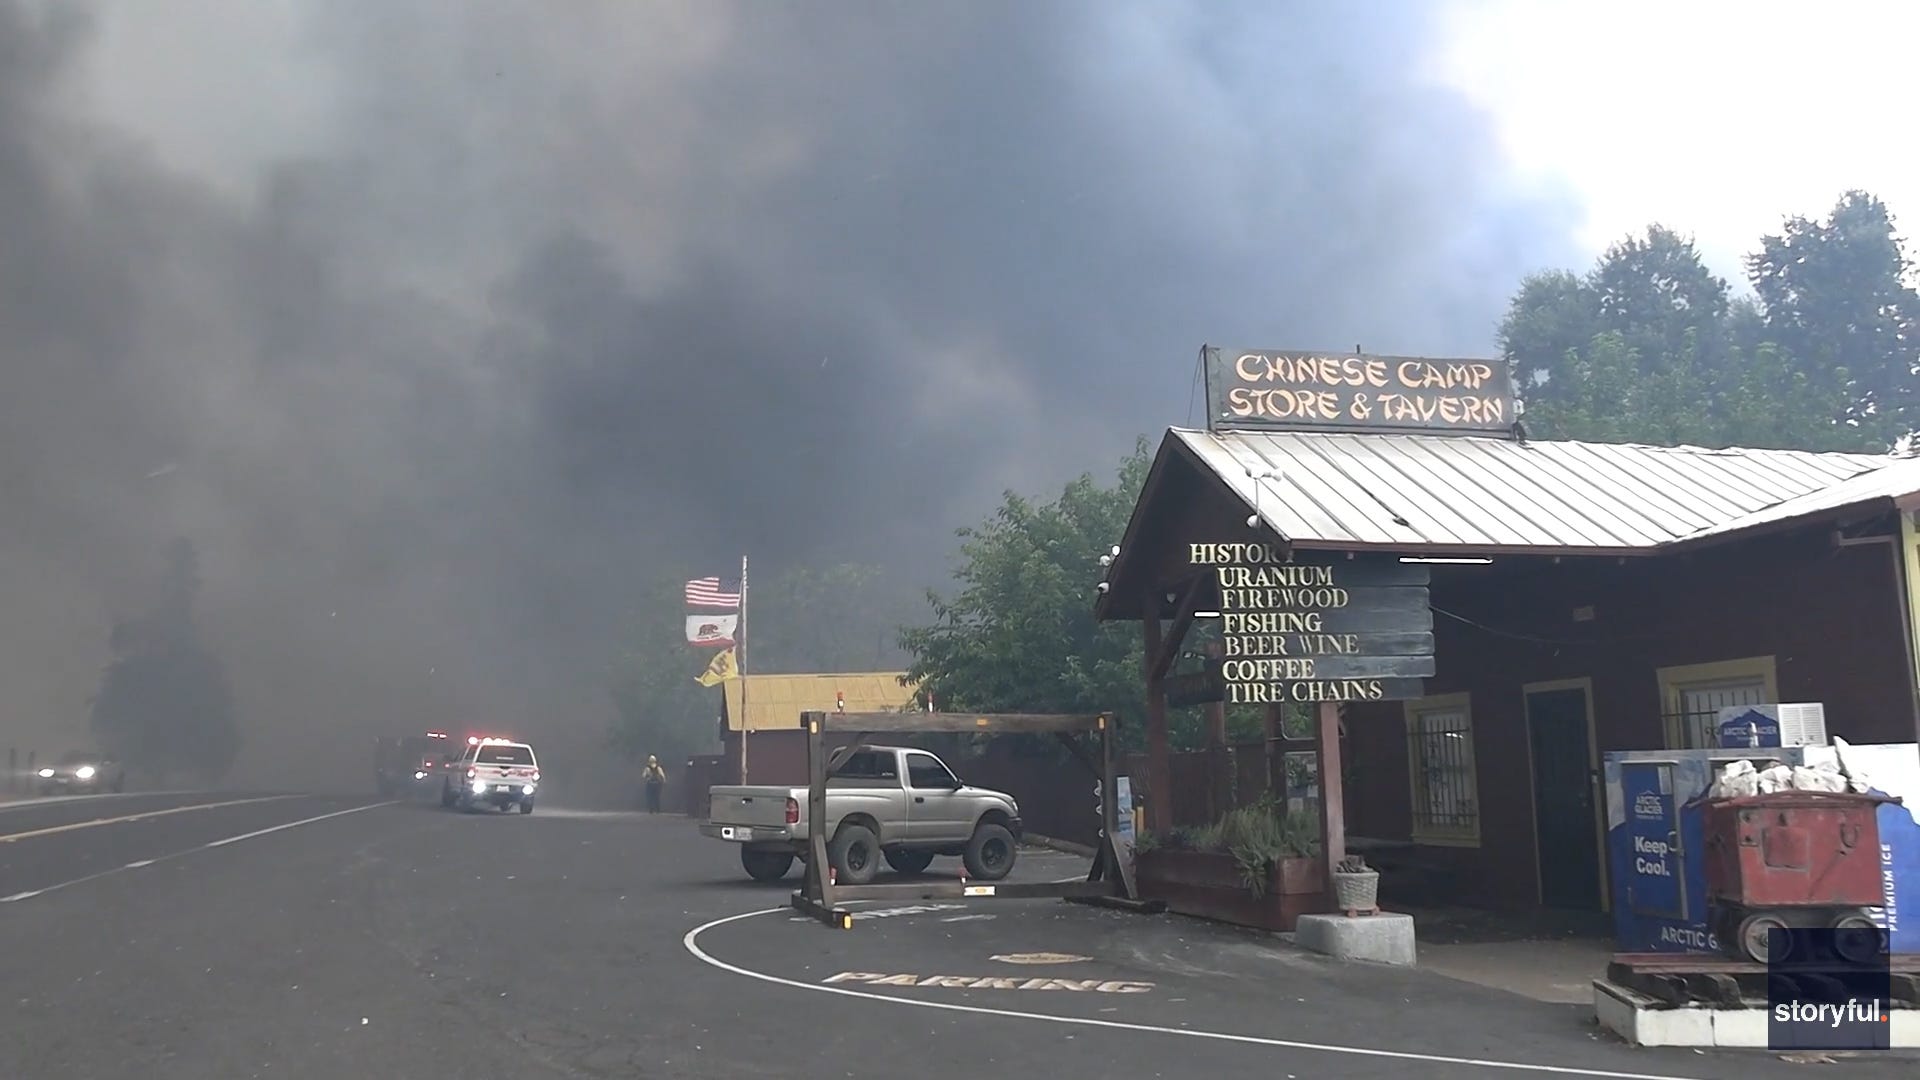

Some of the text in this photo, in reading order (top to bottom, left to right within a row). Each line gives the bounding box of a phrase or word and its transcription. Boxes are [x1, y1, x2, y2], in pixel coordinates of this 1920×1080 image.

[1235, 354, 1492, 390] CHINESE CAMP
[1229, 388, 1504, 424] STORE & TAVERN
[1217, 565, 1334, 587] URANIUM
[1222, 588, 1348, 609] FIREWOOD
[1222, 612, 1323, 634] FISHING
[1225, 633, 1360, 656] BEER WINE
[1222, 658, 1316, 681] COFFEE
[1226, 680, 1383, 703] TIRE CHAINS
[1635, 836, 1668, 858] Keep
[1881, 844, 1893, 865] ICE
[1636, 857, 1671, 876] Cool.
[1661, 926, 1705, 948] ARCTIC
[822, 971, 1156, 993] PARKING
